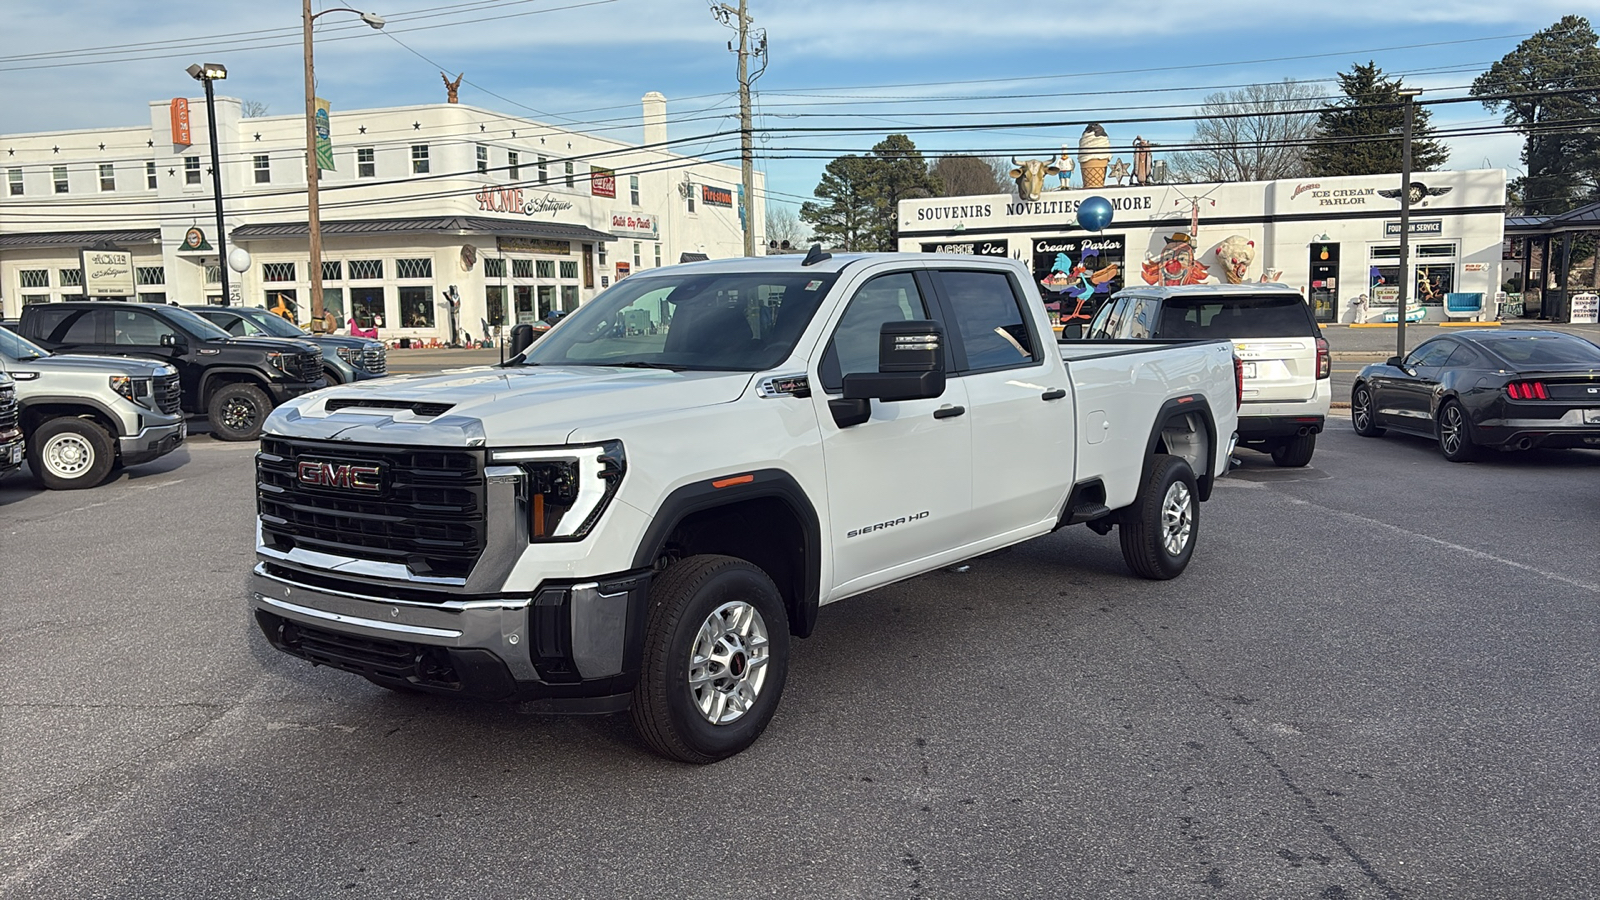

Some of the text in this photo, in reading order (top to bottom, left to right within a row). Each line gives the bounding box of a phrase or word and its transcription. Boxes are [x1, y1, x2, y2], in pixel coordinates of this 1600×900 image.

[180, 101, 188, 141] ACME
[475, 184, 525, 214] ACME
[702, 186, 732, 204] Firestone
[1311, 188, 1375, 198] ICE CREAM
[917, 196, 1152, 221] SOUVENIRS NOVELTIES MORE
[1319, 197, 1366, 206] PARLOR
[627, 216, 636, 230] Boy
[1416, 223, 1440, 231] SERVICE
[935, 243, 1006, 255] ACME Ice
[1036, 239, 1122, 253] Cream Parlor
[230, 292, 241, 301] 25
[298, 461, 380, 491] GMC
[847, 511, 930, 539] SIERRA HD
